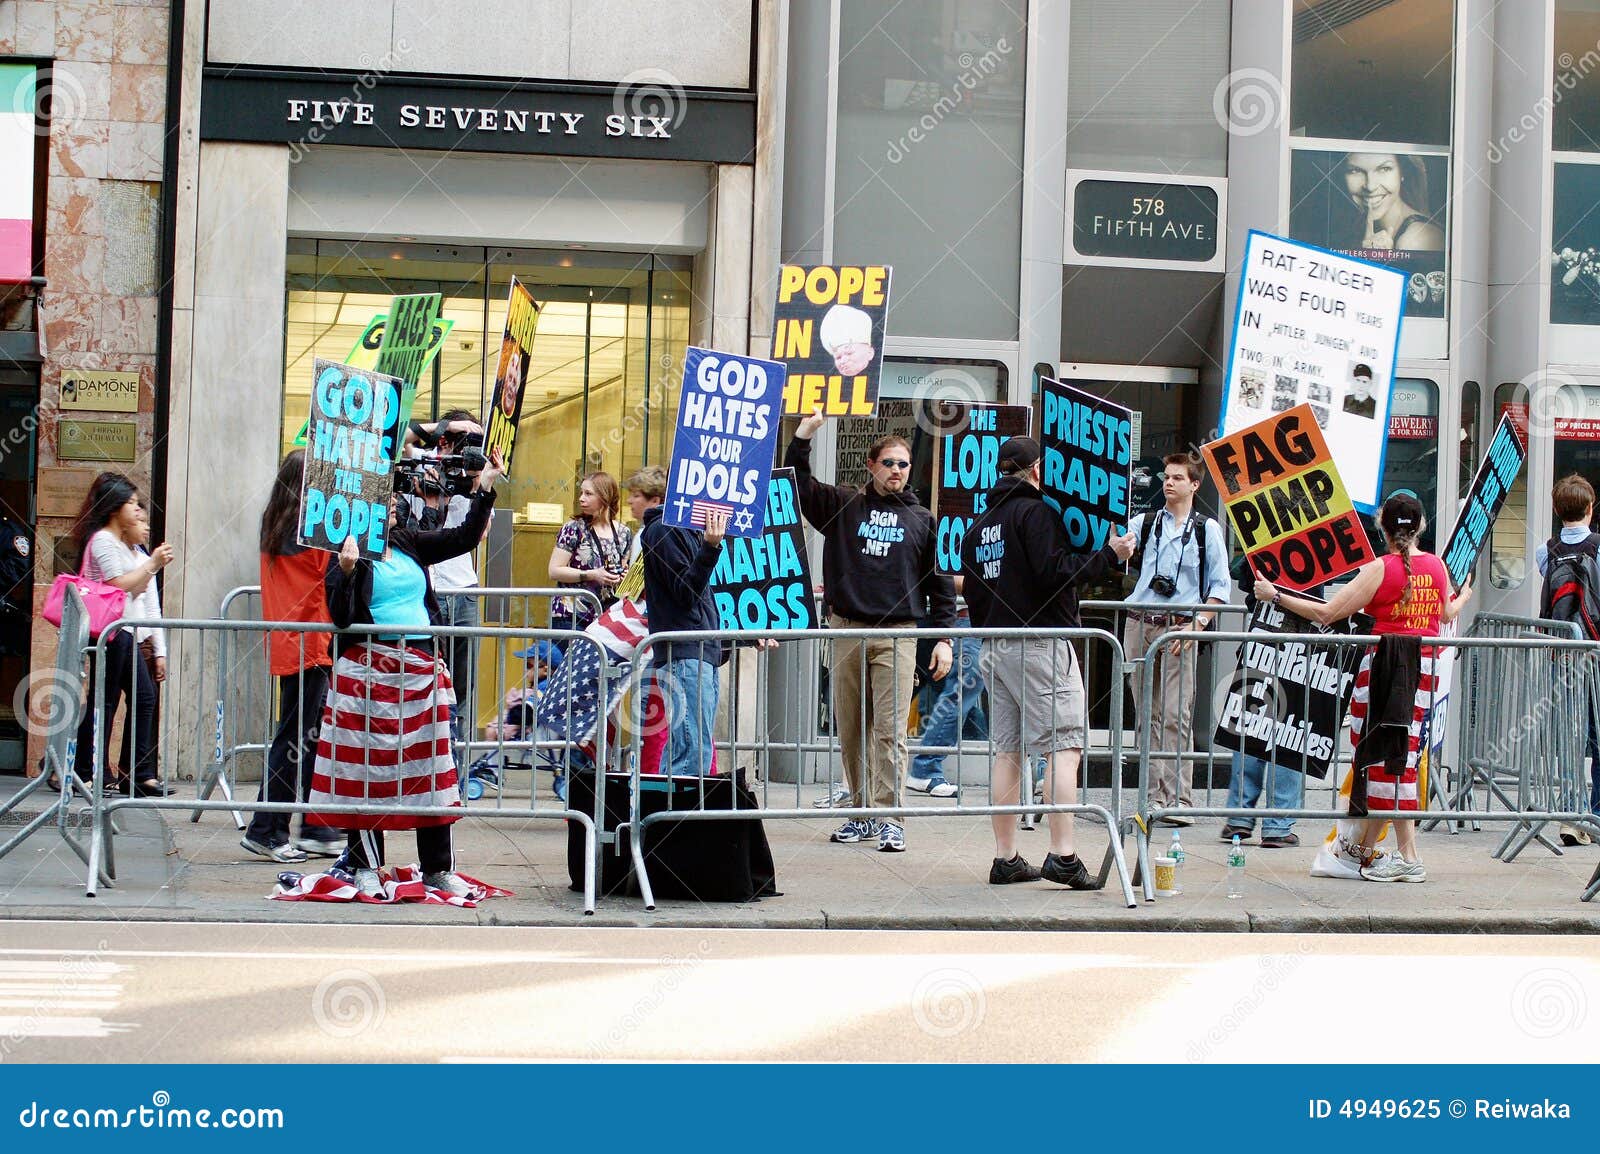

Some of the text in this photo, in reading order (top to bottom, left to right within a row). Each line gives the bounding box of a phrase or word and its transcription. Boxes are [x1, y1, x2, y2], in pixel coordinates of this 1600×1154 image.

[287, 100, 672, 139] FIVE SEVENTY SIX
[1094, 215, 1212, 241] FIFTH AVE.
[1132, 198, 1165, 216] 578
[1371, 250, 1384, 258] ON
[1388, 249, 1411, 260] FIFTH
[779, 265, 886, 306] POPE
[1248, 277, 1289, 303] WAS
[1299, 291, 1347, 319] FOUR
[389, 295, 434, 348] FAGS
[774, 319, 813, 359] IN
[1243, 309, 1262, 330] IN
[1240, 347, 1263, 363] TWO
[696, 355, 768, 400] GOD
[781, 373, 875, 416] HELL
[316, 367, 399, 431] GOD
[683, 392, 772, 440] HATES
[969, 409, 997, 431] THE
[1043, 390, 1131, 467] PRIESTS
[1390, 417, 1433, 430] JEWELRY
[313, 420, 393, 476] HATES
[699, 434, 743, 464] YOUR
[943, 434, 1011, 490] LOR
[1211, 415, 1317, 496] FAG
[1488, 423, 1522, 493] MOURN
[334, 468, 363, 495] THE
[676, 458, 760, 506] IDOLS
[1044, 446, 1128, 516] RAPE
[1479, 470, 1501, 513] FOR
[303, 487, 387, 553] POPE
[869, 509, 898, 527] SIGN
[973, 492, 988, 515] IS
[1230, 468, 1334, 548] PIMP
[1464, 495, 1489, 547] YOUR
[857, 521, 905, 543] MOVIES
[861, 538, 892, 557] .NET
[981, 523, 1001, 545] SIGN
[1250, 515, 1364, 586] POPE
[709, 530, 803, 586] MAFIA
[982, 559, 1001, 580] .NET
[1446, 525, 1476, 587] SINS
[1408, 574, 1433, 588] GOD
[714, 582, 810, 630] BOSS
[1256, 600, 1285, 628] The
[1252, 676, 1273, 700] of
[1219, 691, 1334, 762] Pedophiles
